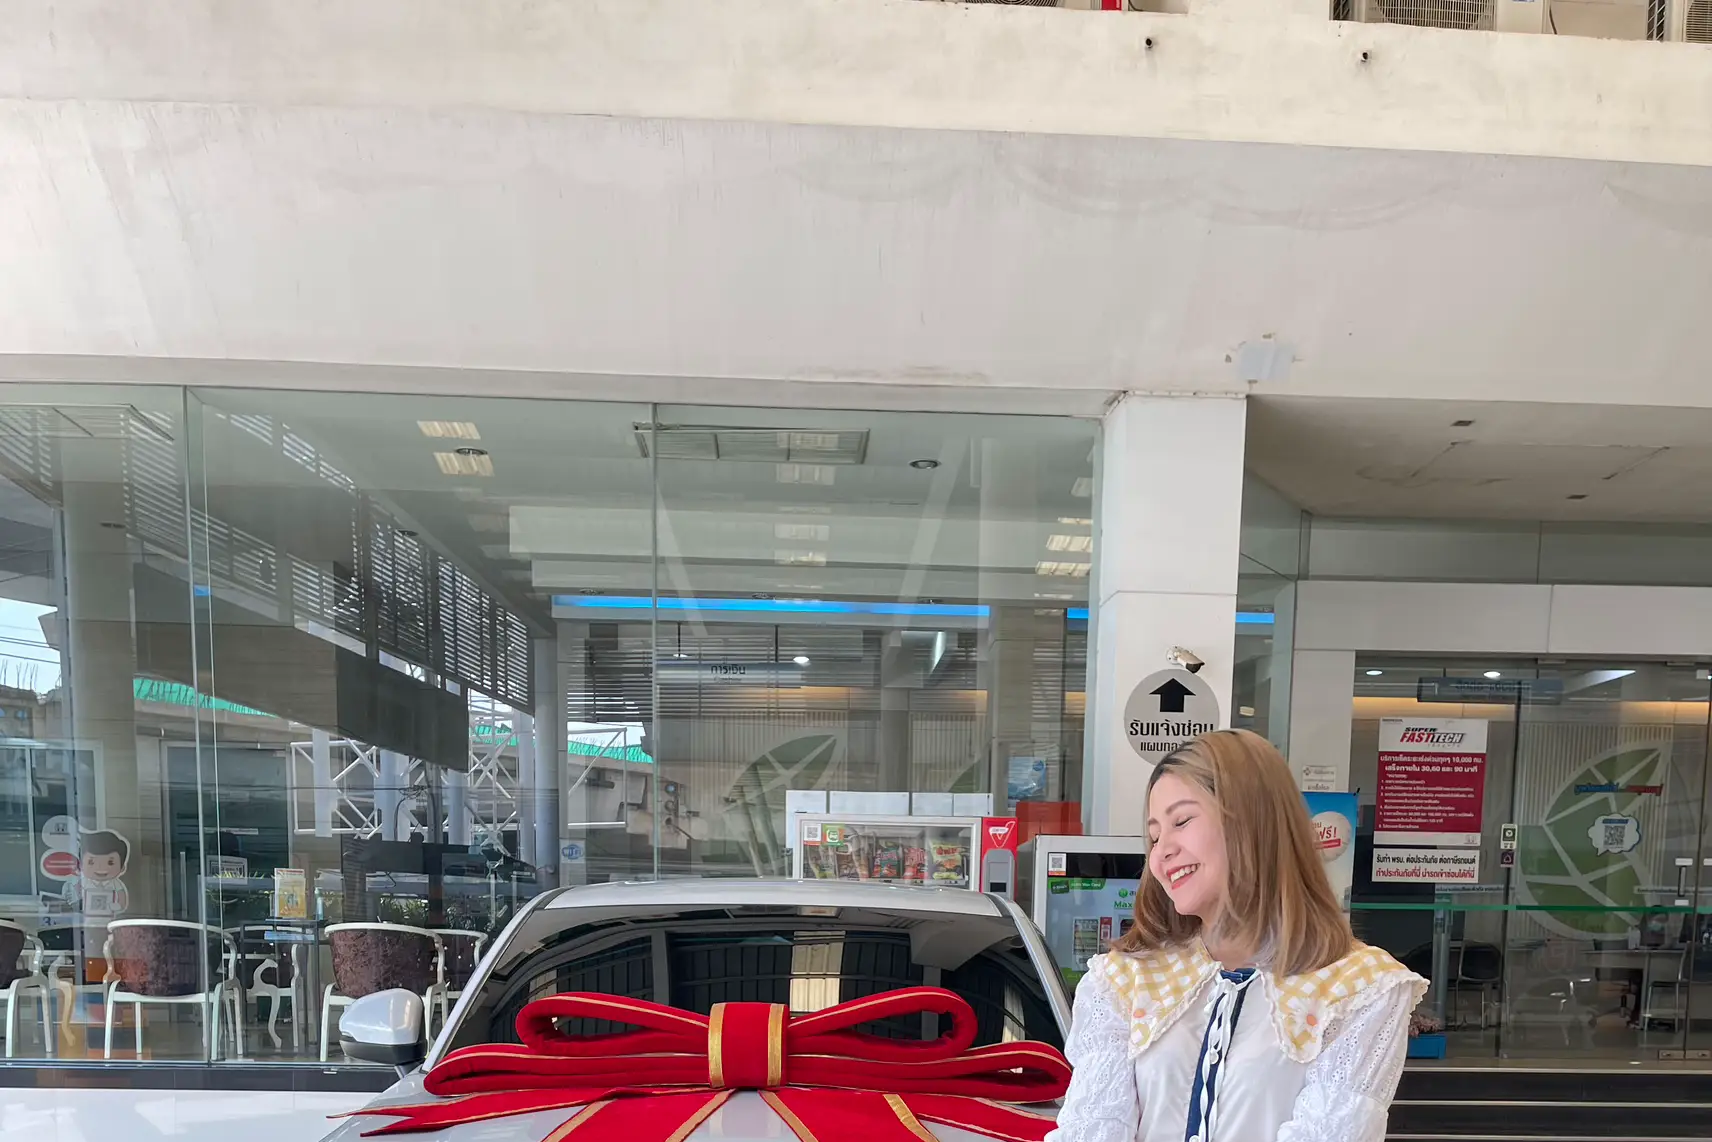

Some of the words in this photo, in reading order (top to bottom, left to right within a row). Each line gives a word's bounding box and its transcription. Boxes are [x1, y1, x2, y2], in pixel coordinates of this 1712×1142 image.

[710, 663, 746, 674] การเงิน
[1114, 900, 1133, 909] Max
